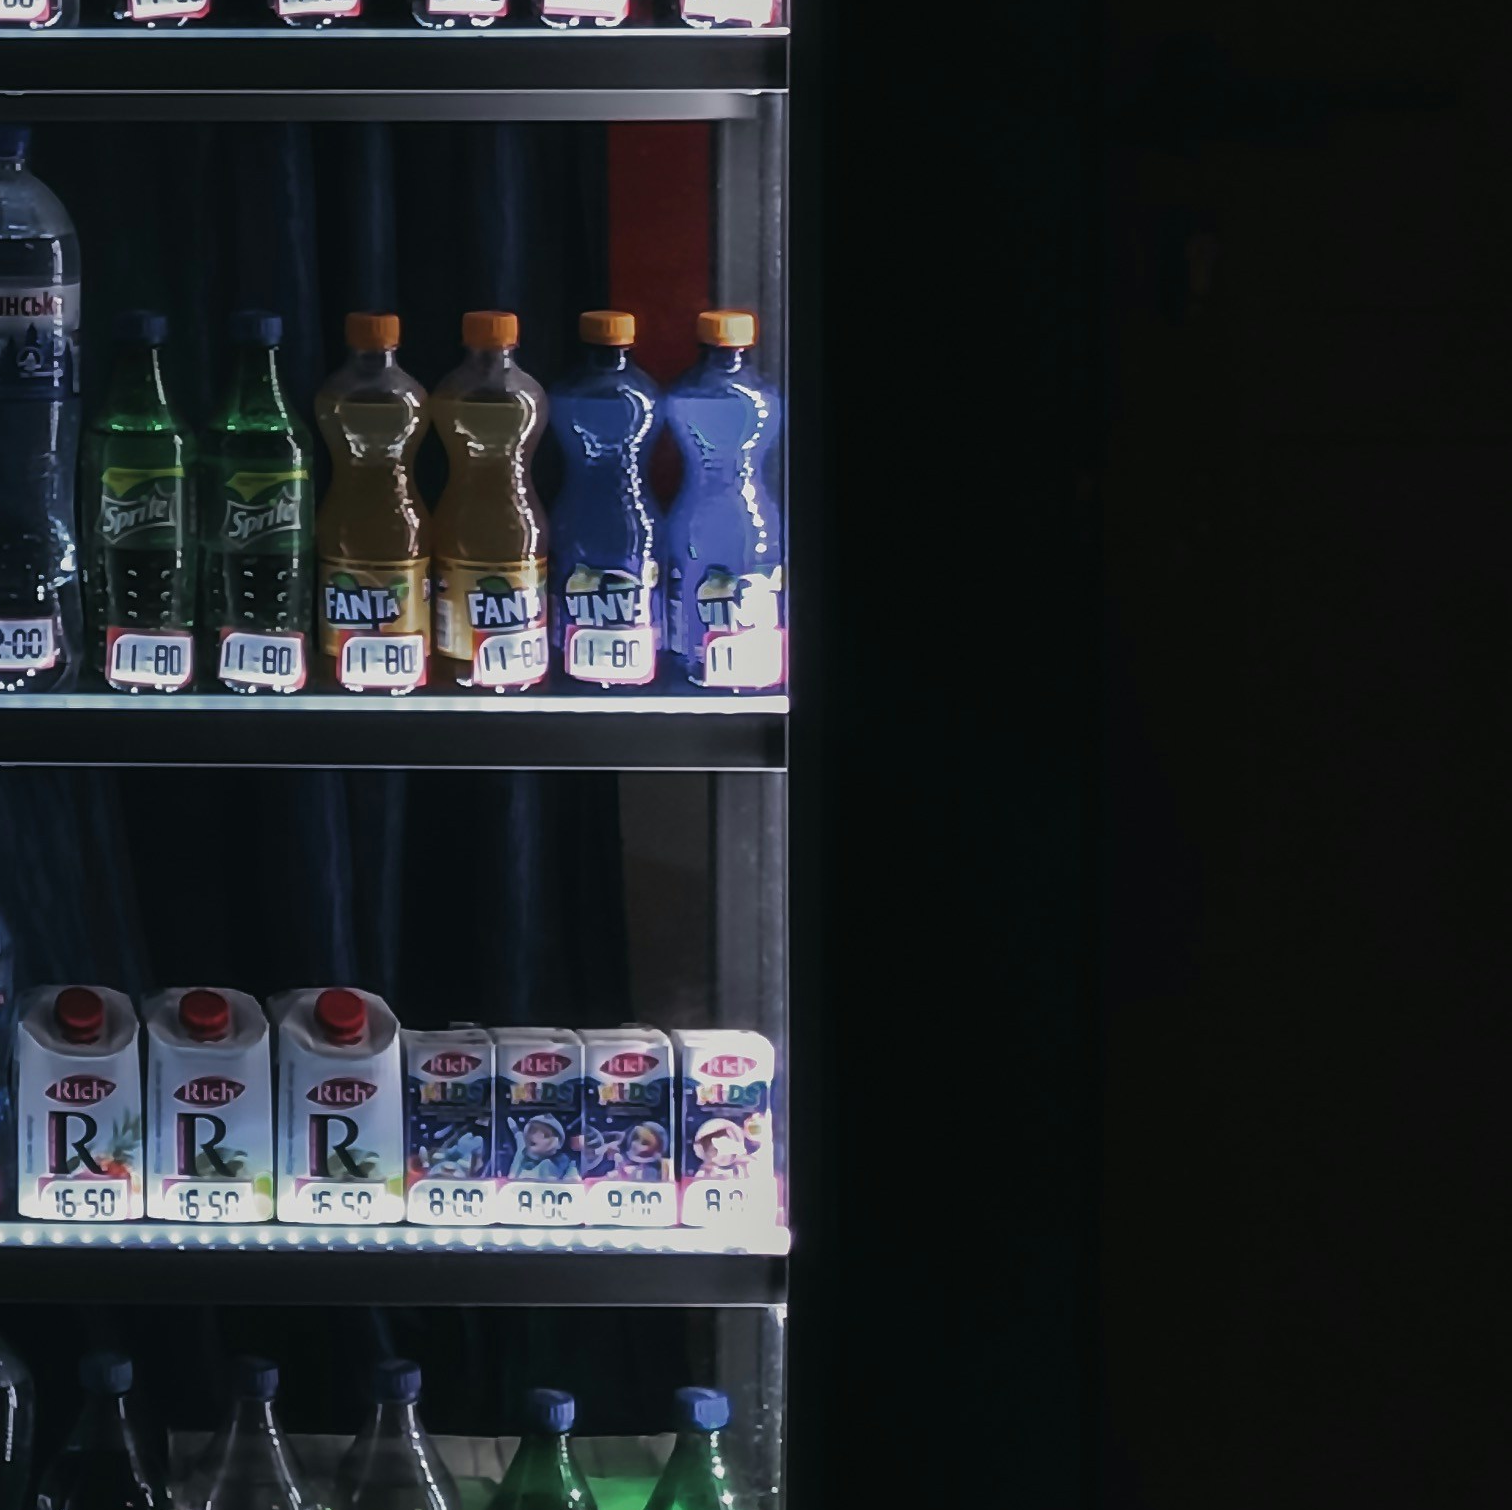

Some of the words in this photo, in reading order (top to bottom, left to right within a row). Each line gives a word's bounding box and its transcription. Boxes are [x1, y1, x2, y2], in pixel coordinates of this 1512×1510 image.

[103, 497, 168, 538] Sprite
[228, 499, 296, 540] Sprite
[325, 585, 400, 624] FANTA
[469, 592, 541, 625] FANT
[56, 1079, 106, 1102] Rich
[184, 1081, 235, 1103] Rich
[316, 1082, 367, 1103] Rich
[49, 1111, 108, 1175] R
[177, 1112, 236, 1177] R
[309, 1113, 369, 1177] R
[56, 1188, 115, 1218] 16-50
